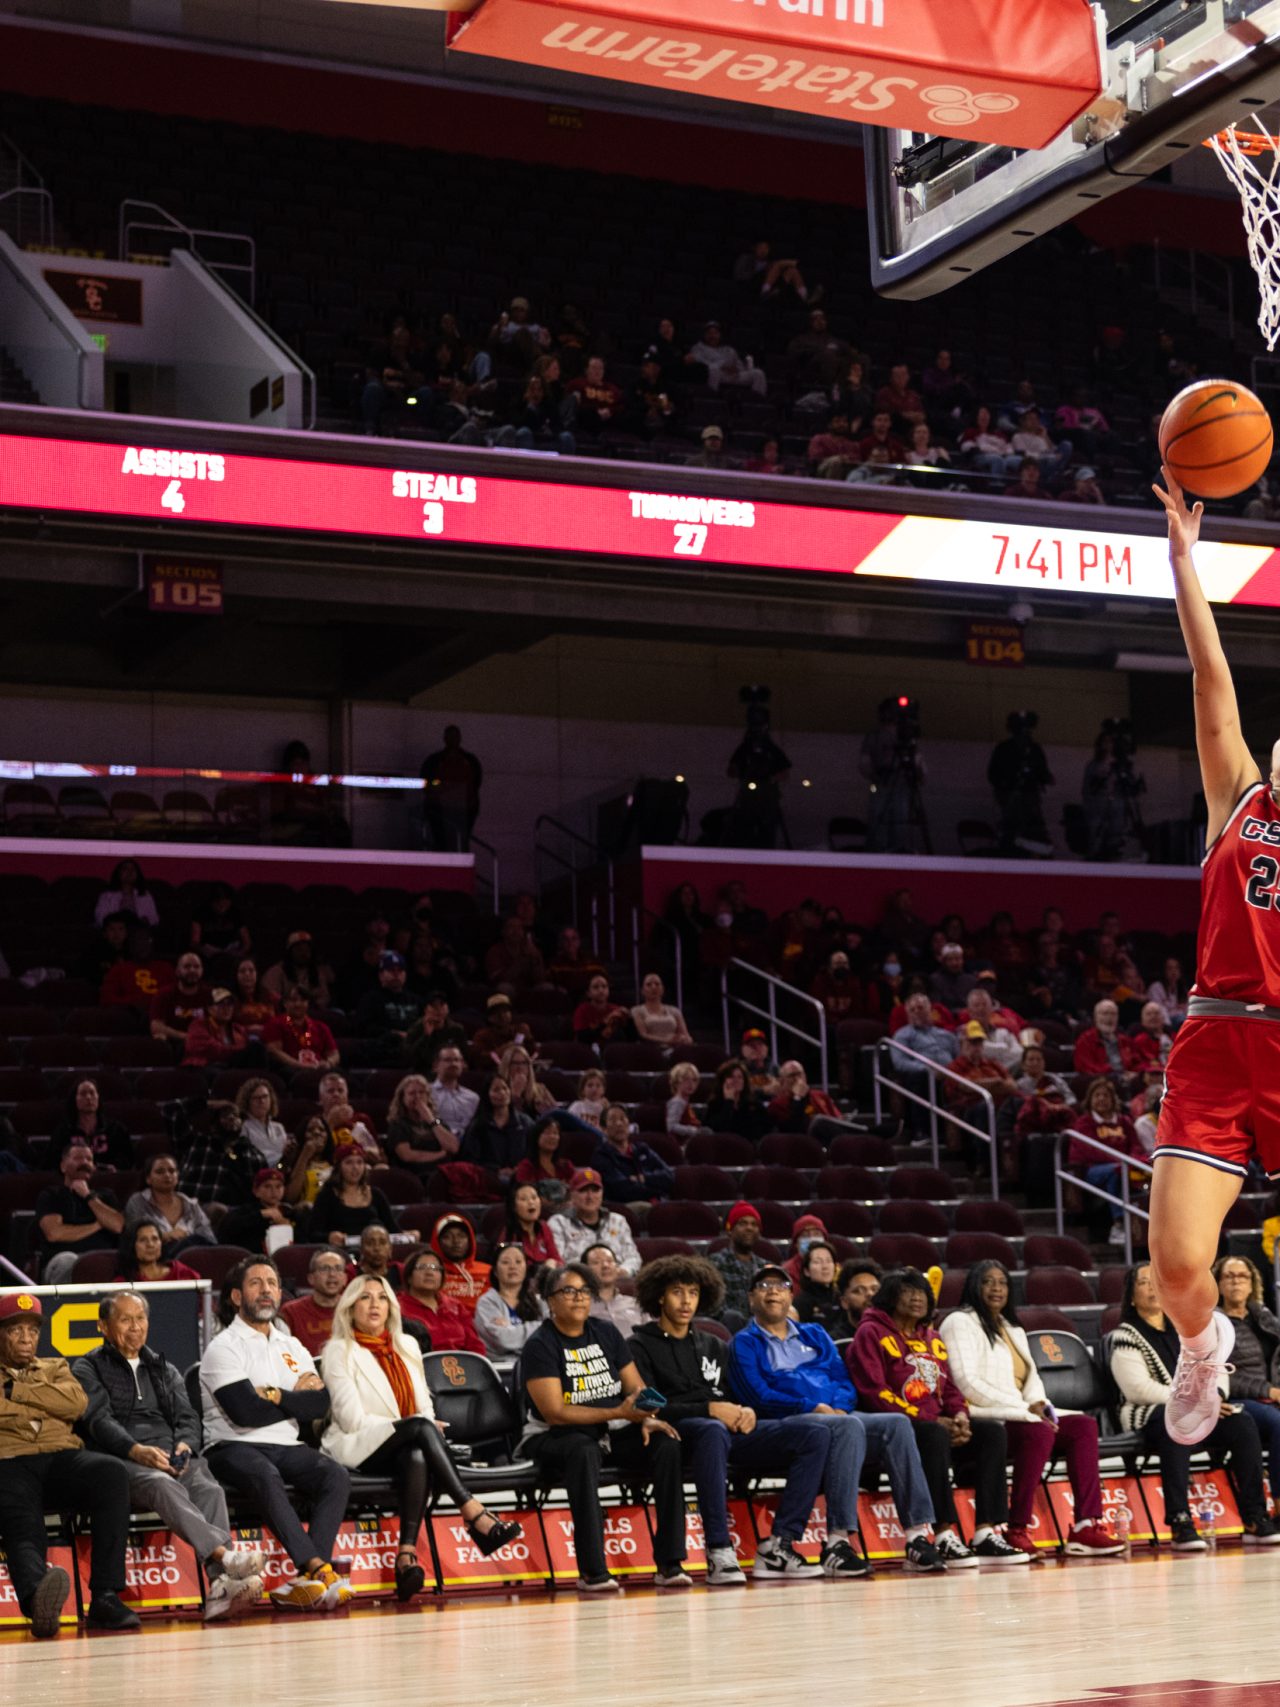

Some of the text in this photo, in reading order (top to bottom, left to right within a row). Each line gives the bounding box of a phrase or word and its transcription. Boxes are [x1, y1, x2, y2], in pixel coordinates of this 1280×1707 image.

[121, 446, 225, 481] ASSISTS
[161, 480, 185, 513] 4
[392, 471, 476, 503] STEALS
[423, 502, 443, 534] 3
[629, 492, 755, 527] TURNOVERS
[674, 524, 707, 555] 27
[1080, 543, 1131, 585] PM
[151, 581, 222, 607] 105
[966, 639, 1025, 663] 104
[125, 1544, 177, 1564] ELLS
